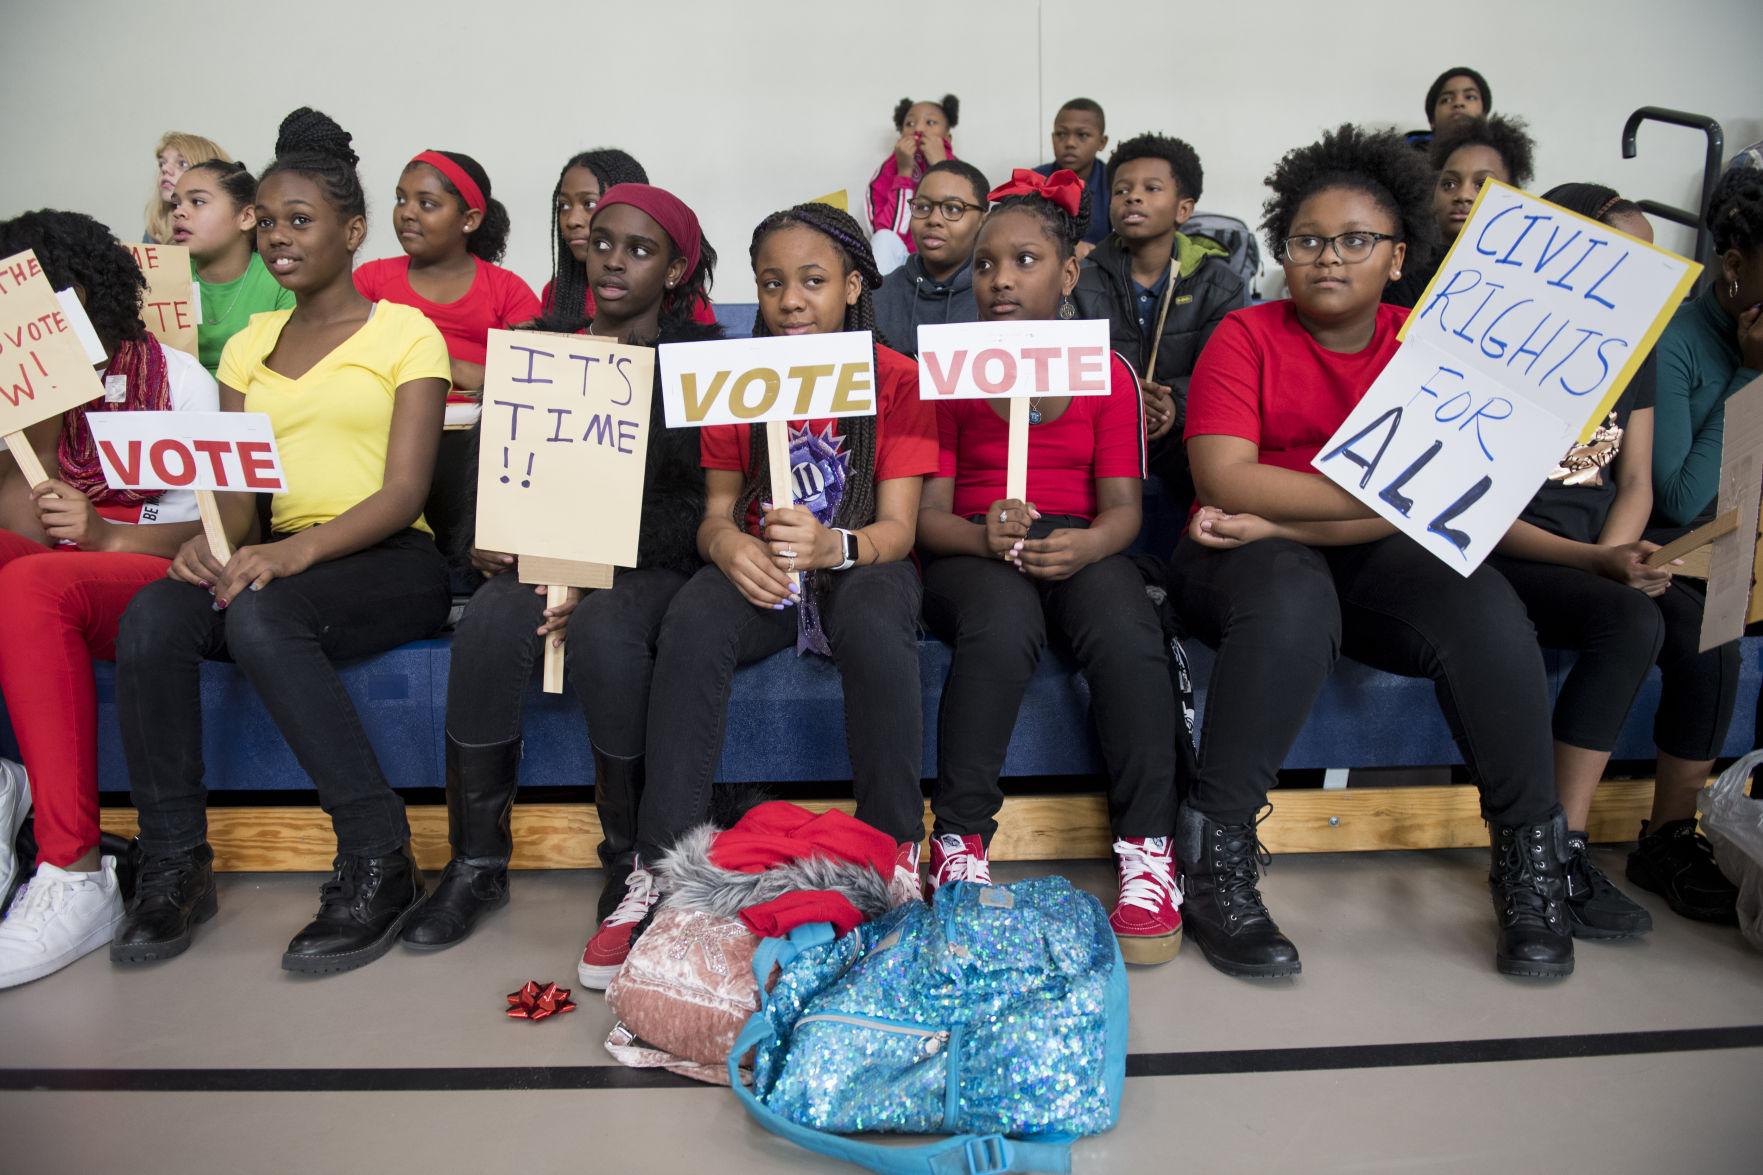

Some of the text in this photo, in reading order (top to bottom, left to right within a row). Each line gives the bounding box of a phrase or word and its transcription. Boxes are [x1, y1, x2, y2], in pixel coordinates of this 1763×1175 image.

[1475, 203, 1630, 309] CIVIL
[4, 311, 68, 348] VOTE
[1420, 268, 1628, 397] RIGHTS
[509, 344, 632, 406] IT'S
[680, 361, 872, 423] VOTE
[922, 346, 1106, 396] VOTE
[493, 399, 640, 455] TIME
[1406, 366, 1514, 462] FOR
[98, 438, 282, 489] VOTE
[1319, 405, 1493, 561] ALL
[142, 506, 159, 521] BE
